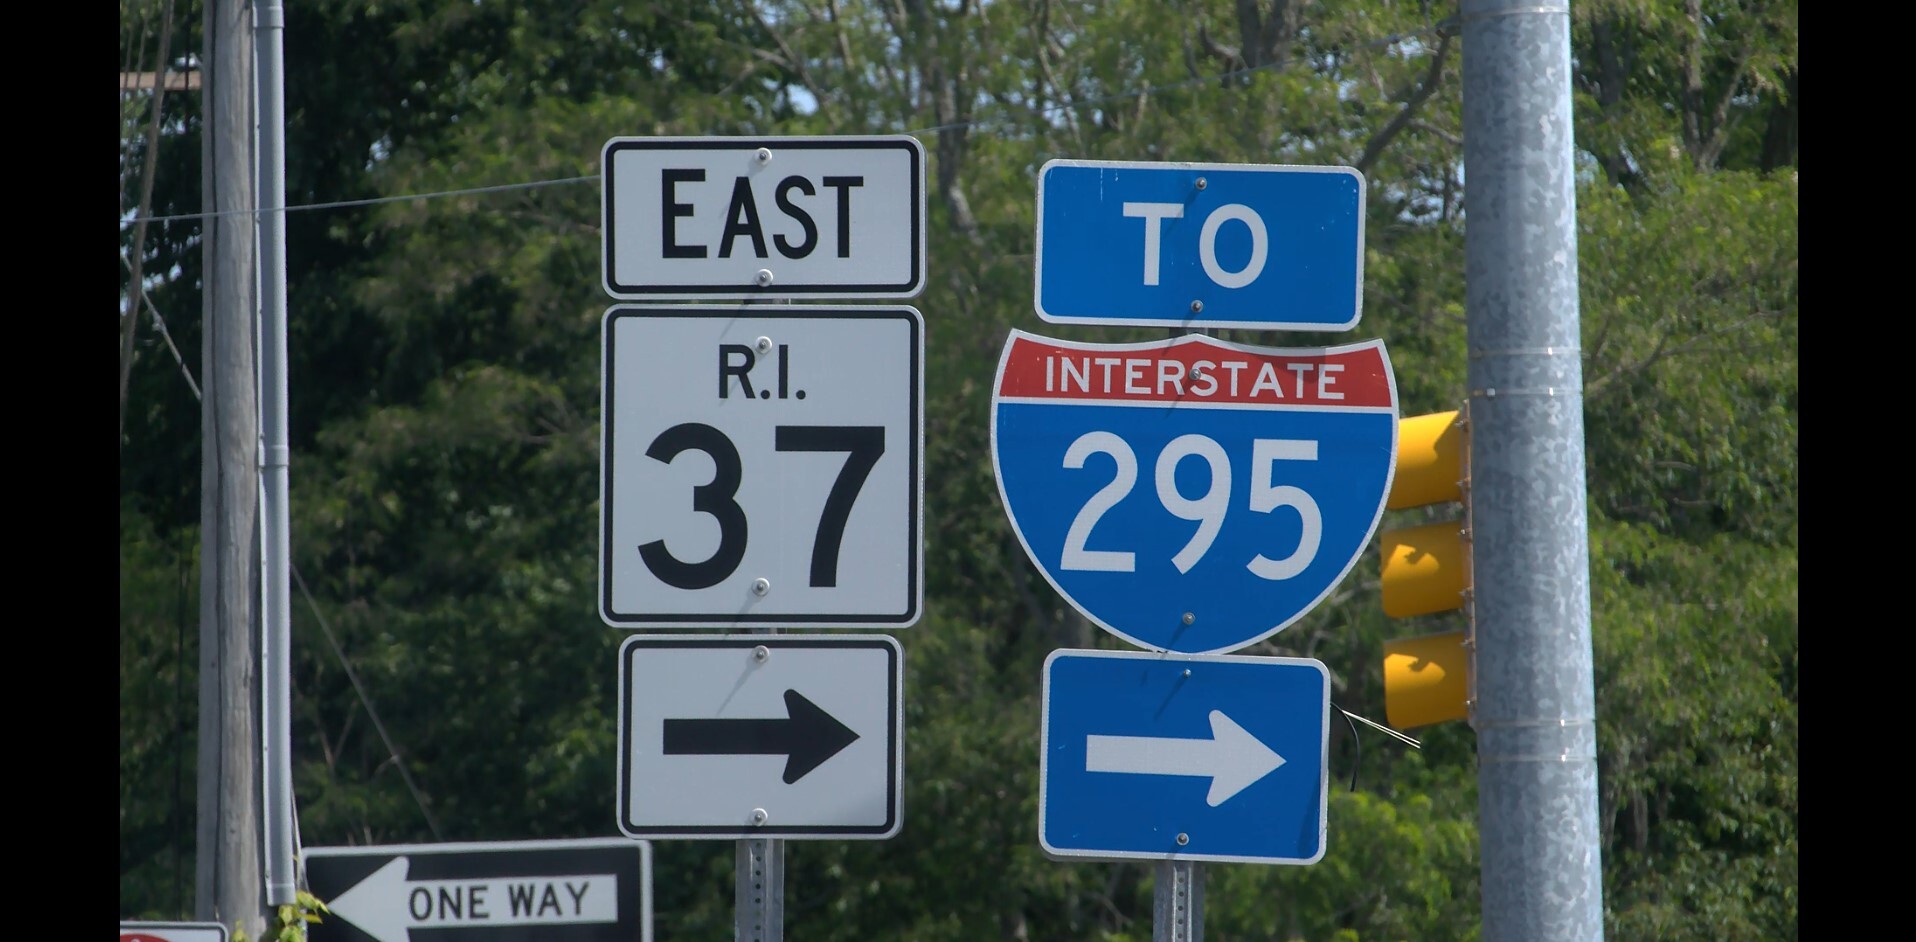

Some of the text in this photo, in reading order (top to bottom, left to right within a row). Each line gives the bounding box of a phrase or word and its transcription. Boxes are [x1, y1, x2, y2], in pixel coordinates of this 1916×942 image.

[661, 168, 864, 260] EAST
[1122, 201, 1269, 289] TO
[718, 344, 807, 400] R.I.
[1045, 355, 1346, 400] INTERSTATE
[637, 422, 886, 590] 37
[1060, 430, 1323, 581] 295
[408, 881, 591, 921] ONE WAY
